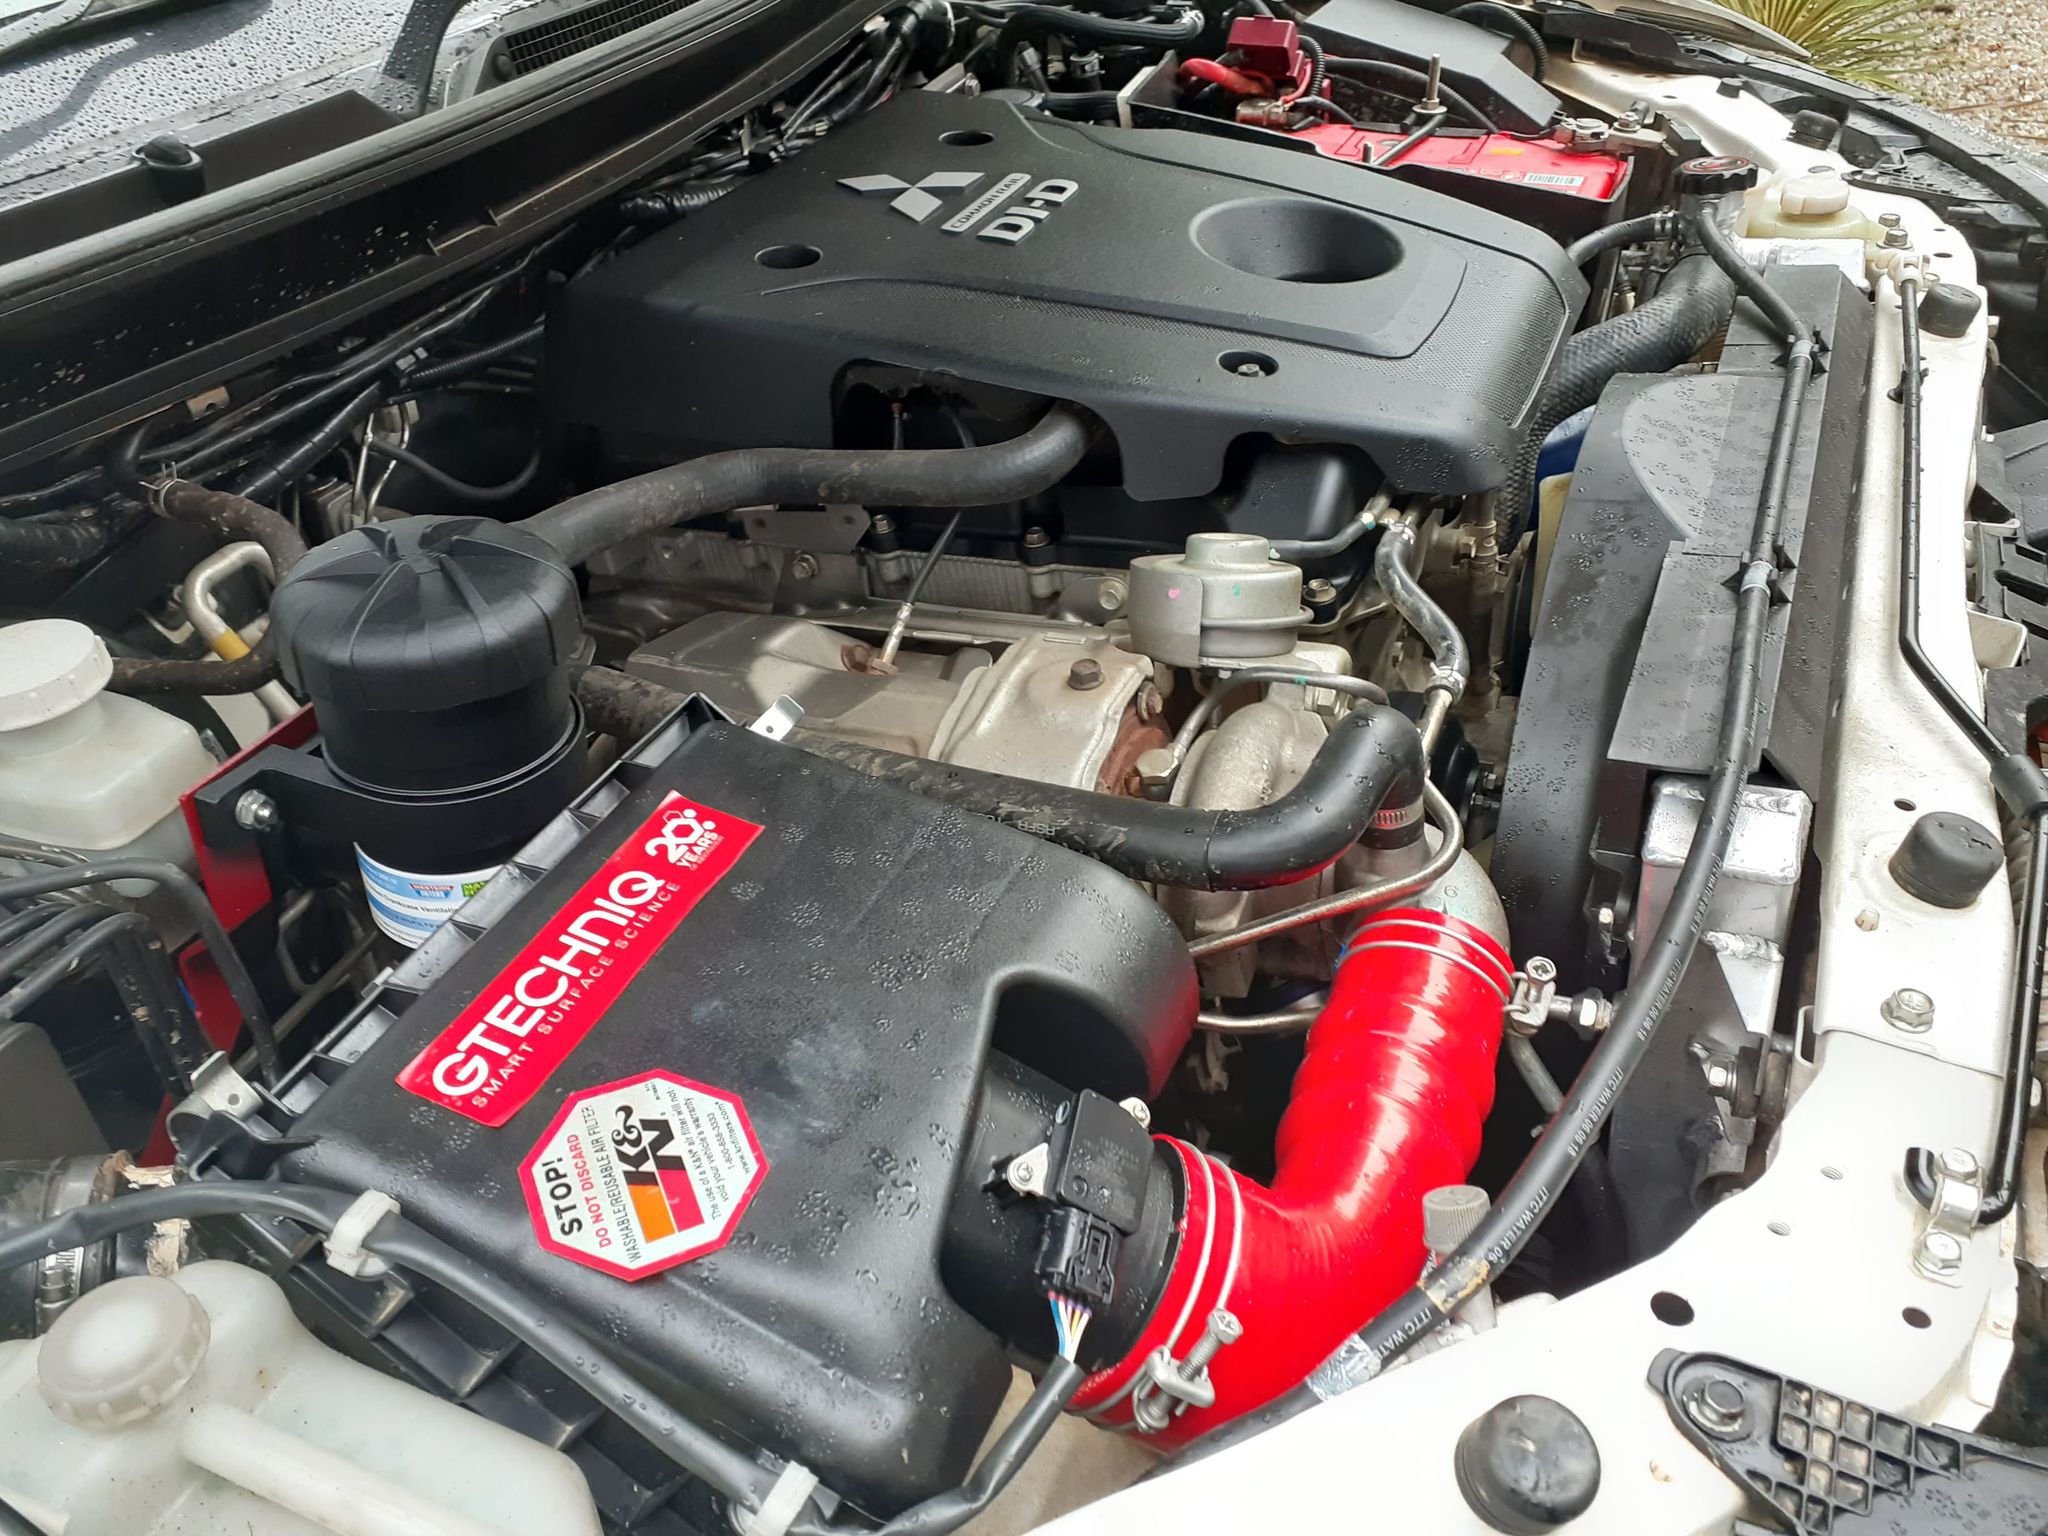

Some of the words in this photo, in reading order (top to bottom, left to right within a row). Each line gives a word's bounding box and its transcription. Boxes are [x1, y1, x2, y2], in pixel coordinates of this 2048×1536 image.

[950, 194, 1000, 228] COMMON
[996, 176, 1026, 196] RAIL
[976, 179, 1079, 242] DI-D
[676, 830, 719, 868] YEARS
[432, 870, 666, 1097] GTECHNIQ
[471, 1041, 535, 1108] SMART
[536, 955, 615, 1036] SURFACE
[613, 881, 681, 950] SCIENCE
[1655, 978, 1674, 1010] WATER
[1636, 1028, 1647, 1041] 18
[1608, 1067, 1624, 1091] ITTC
[672, 1104, 683, 1117] will
[684, 1098, 702, 1130] warranty
[1588, 1087, 1614, 1122] WATER
[581, 1105, 601, 1136] FILTER
[678, 1116, 690, 1136] filter
[1582, 1118, 1594, 1134] 06
[592, 1136, 606, 1154] AIR
[685, 1136, 695, 1147] air
[696, 1130, 715, 1164] vehicle's
[1568, 1142, 1578, 1157] 18
[1575, 1130, 1586, 1144] 06
[566, 1134, 594, 1192] DISCARD
[710, 1164, 726, 1184] your
[698, 1178, 709, 1186] of
[706, 1186, 716, 1203] use
[717, 1184, 730, 1202] void
[542, 1157, 583, 1237] STOP!
[584, 1196, 605, 1225] NOT
[596, 1154, 642, 1263] WASHABLE/REUSABLE
[1530, 1186, 1550, 1214] ITTC
[711, 1203, 722, 1220] The
[596, 1227, 612, 1248] DO
[1500, 1208, 1534, 1250] WATER
[1488, 1246, 1503, 1264] 06
[1404, 1307, 1432, 1336] ITTC
